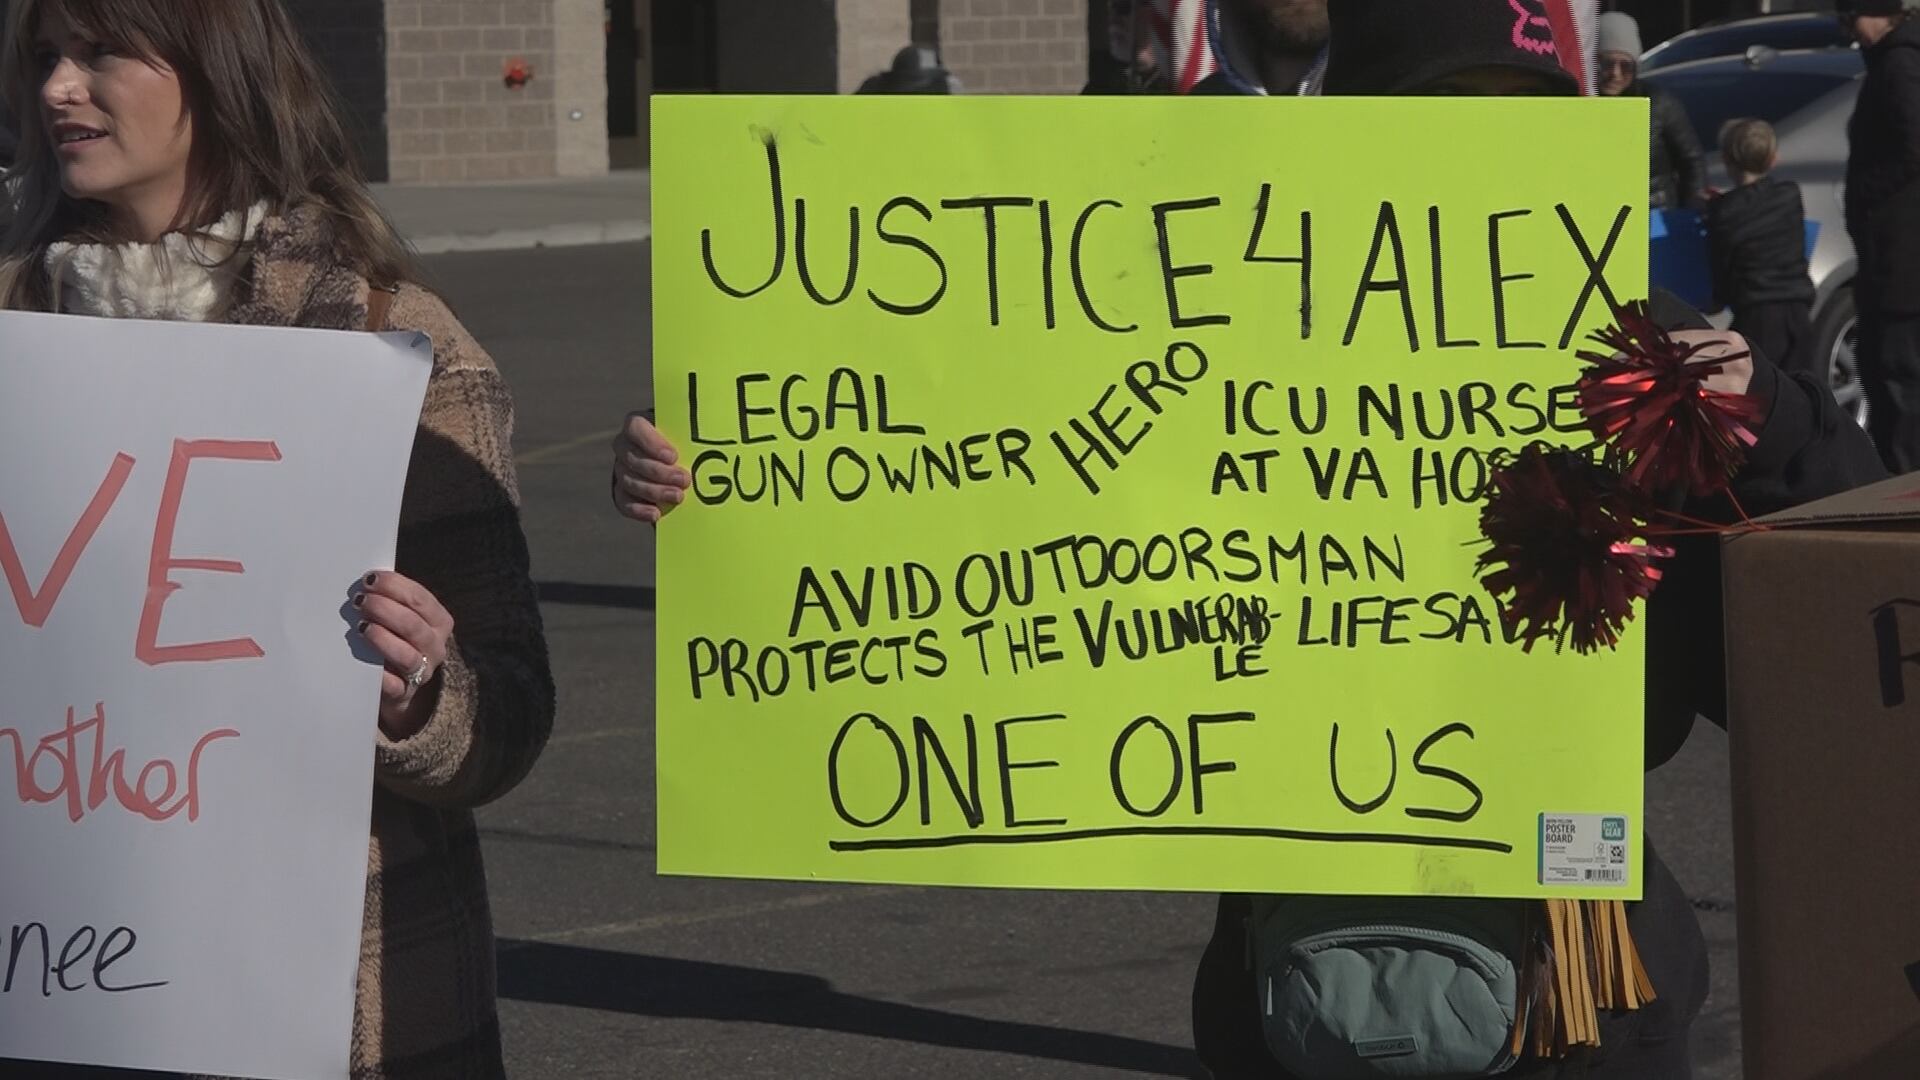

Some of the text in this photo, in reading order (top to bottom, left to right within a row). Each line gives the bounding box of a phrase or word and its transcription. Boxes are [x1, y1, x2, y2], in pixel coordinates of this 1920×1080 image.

[701, 134, 1632, 352] JUSTICE 4 ALEX
[688, 367, 926, 445] LEGAL
[1049, 341, 1209, 495] HERO
[1224, 380, 1580, 441] ICU NURSE
[691, 428, 1037, 507] GUN OWNER
[1211, 449, 1281, 495] AT
[1303, 447, 1388, 501] VA
[788, 527, 1406, 638] AVID OUTDOORSMAN
[687, 628, 948, 703] PROTECTS
[961, 614, 1064, 675] THE
[1214, 644, 1270, 682] LE
[828, 711, 1483, 828] ONE OF US
[1545, 824, 1576, 834] POSTER
[1545, 834, 1573, 843] BOARD
[0, 921, 169, 997] nee
